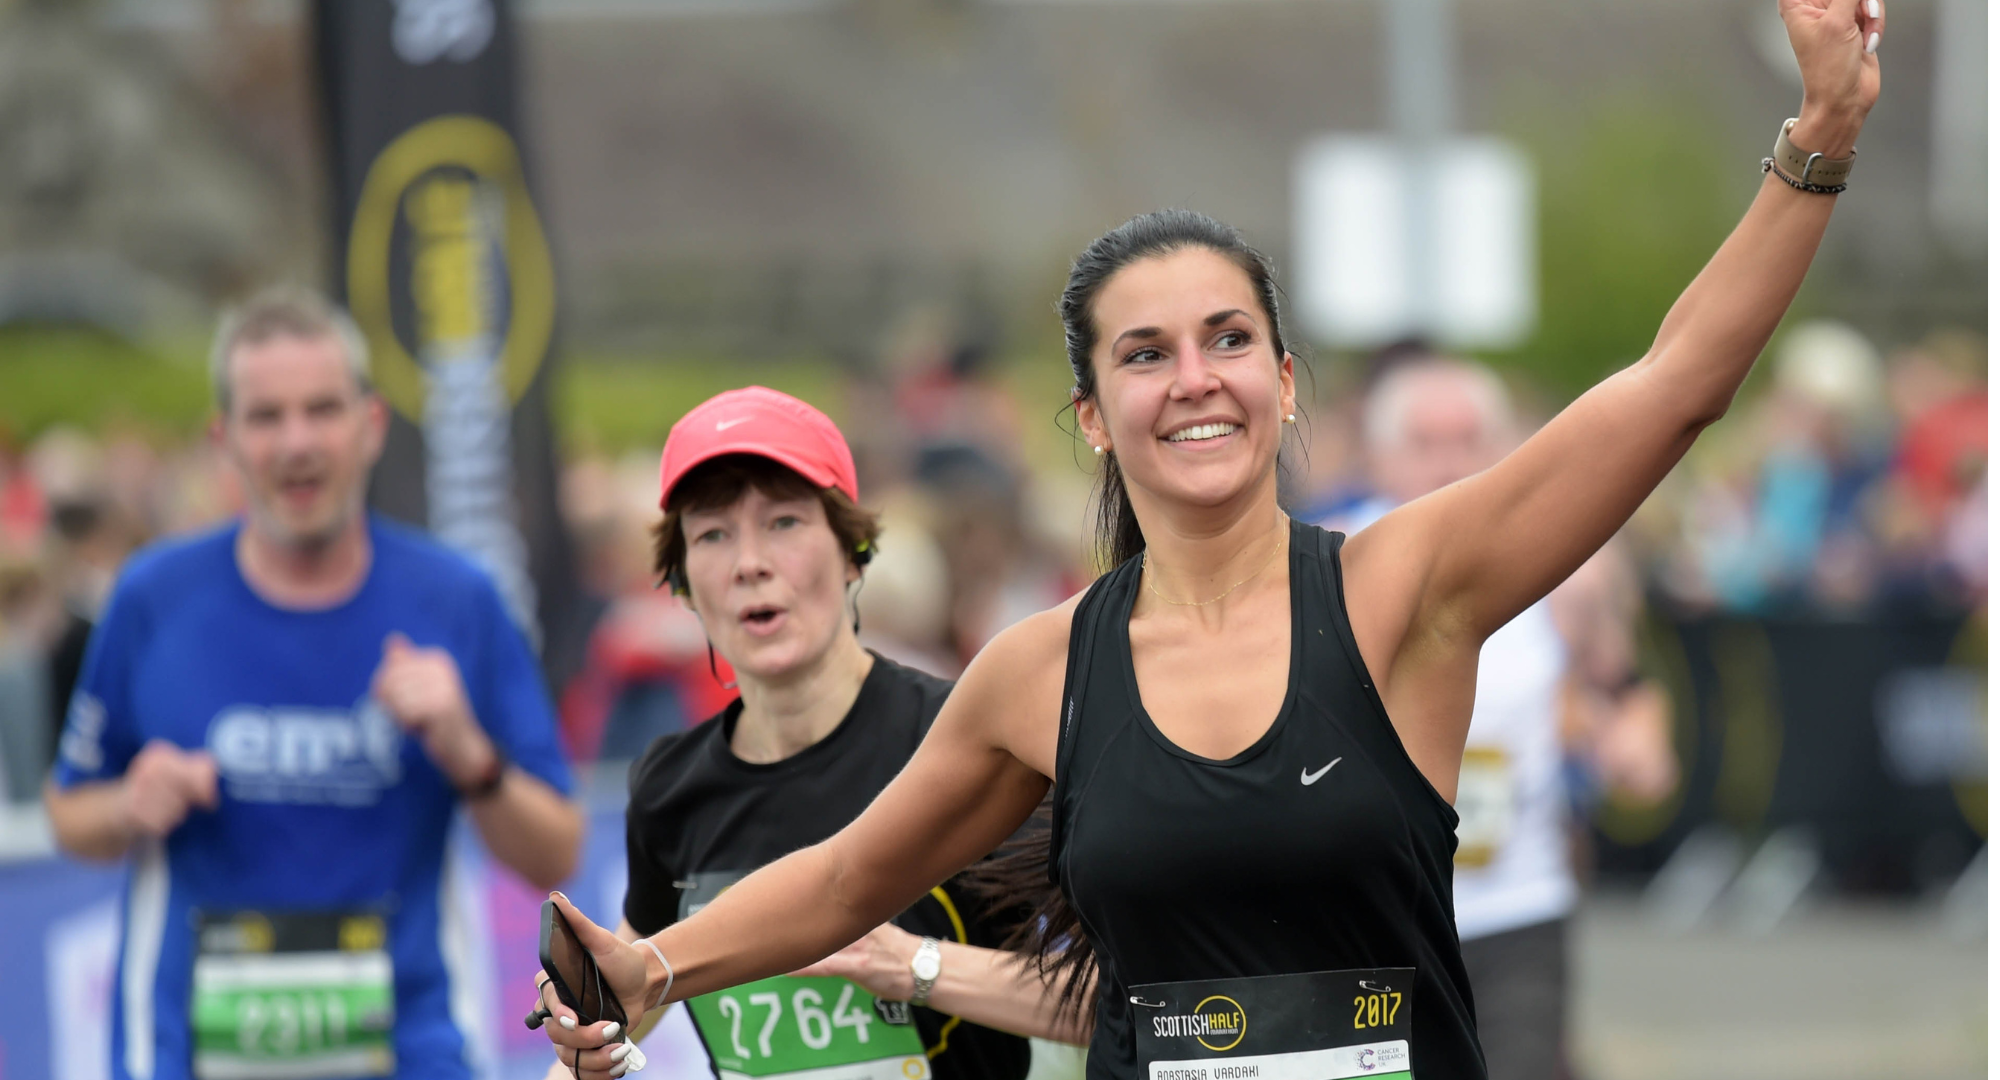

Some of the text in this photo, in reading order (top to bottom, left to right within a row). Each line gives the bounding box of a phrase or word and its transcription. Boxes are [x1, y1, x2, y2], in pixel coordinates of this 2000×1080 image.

[718, 984, 873, 1059] 2764
[1354, 992, 1402, 1029] 2017
[1377, 1053, 1406, 1061] RESEARCH
[1214, 1065, 1259, 1080] VARDAKI
